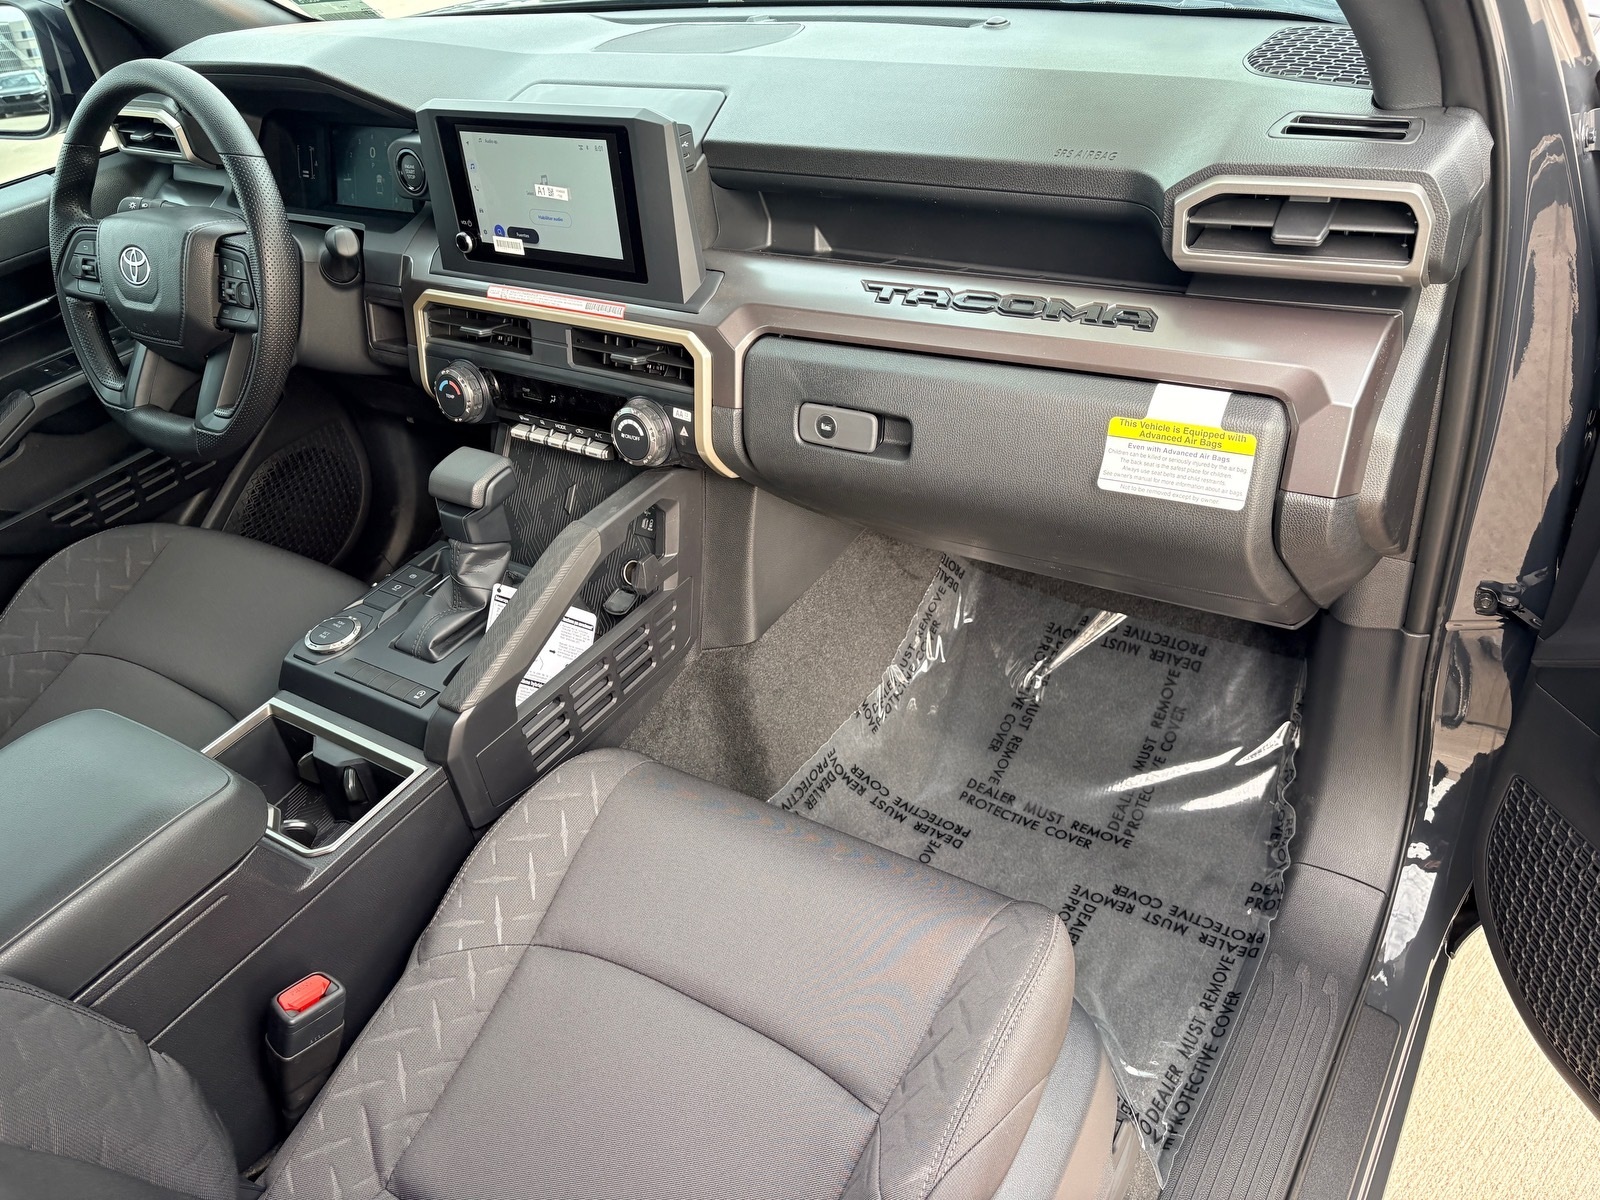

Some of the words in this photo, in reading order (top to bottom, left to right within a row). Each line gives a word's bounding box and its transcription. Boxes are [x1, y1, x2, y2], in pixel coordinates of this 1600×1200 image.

[1054, 148, 1074, 158] SRS
[1074, 150, 1118, 161] AIRBAG
[860, 279, 1159, 332] TACOMA
[624, 433, 641, 442] ON/OFF
[1119, 419, 1138, 428] This
[1140, 422, 1171, 432] Vehicle
[1173, 426, 1181, 434] is
[1182, 427, 1226, 441] Equipped
[1227, 433, 1248, 443] with
[1139, 431, 1183, 443] Advanced
[1184, 437, 1198, 445] Air
[1199, 439, 1223, 450] Bags
[1127, 443, 1146, 451] Even
[1162, 448, 1199, 458] Advanced
[1211, 455, 1231, 464] Bags
[1100, 636, 1141, 657] MUST
[1122, 624, 1208, 658] PROTECTIVE
[1149, 648, 1203, 673] DEALER
[988, 713, 1016, 752] COVER
[1132, 736, 1158, 772] MUST
[1151, 668, 1181, 730] REMOVE
[1160, 705, 1188, 753] COVER
[826, 747, 867, 797] REMOVE
[988, 734, 1023, 786] REMOVE
[803, 769, 837, 811] DEALER
[849, 763, 890, 797] COVER
[869, 795, 908, 824] MUST
[892, 796, 972, 839] PROTECTIVE
[958, 790, 1041, 831] PROTECTIVE
[1044, 825, 1093, 850] COVER
[966, 778, 1017, 807] DEALER
[1022, 801, 1065, 825] MUST
[1070, 820, 1133, 850] REMOVE
[913, 820, 964, 849] DEALER
[1070, 883, 1136, 915] REMOVE
[1112, 883, 1163, 909] COVER
[1142, 911, 1189, 937] MUST
[1168, 904, 1266, 944] PROTECTIVE
[1198, 931, 1260, 959] DEALER
[1145, 1064, 1184, 1125] DEALER
[1176, 1015, 1207, 1061] MUST
[1198, 955, 1236, 1012] REMOVE
[1167, 1042, 1219, 1135] PROTECTIVE
[1210, 990, 1242, 1038] COVER
